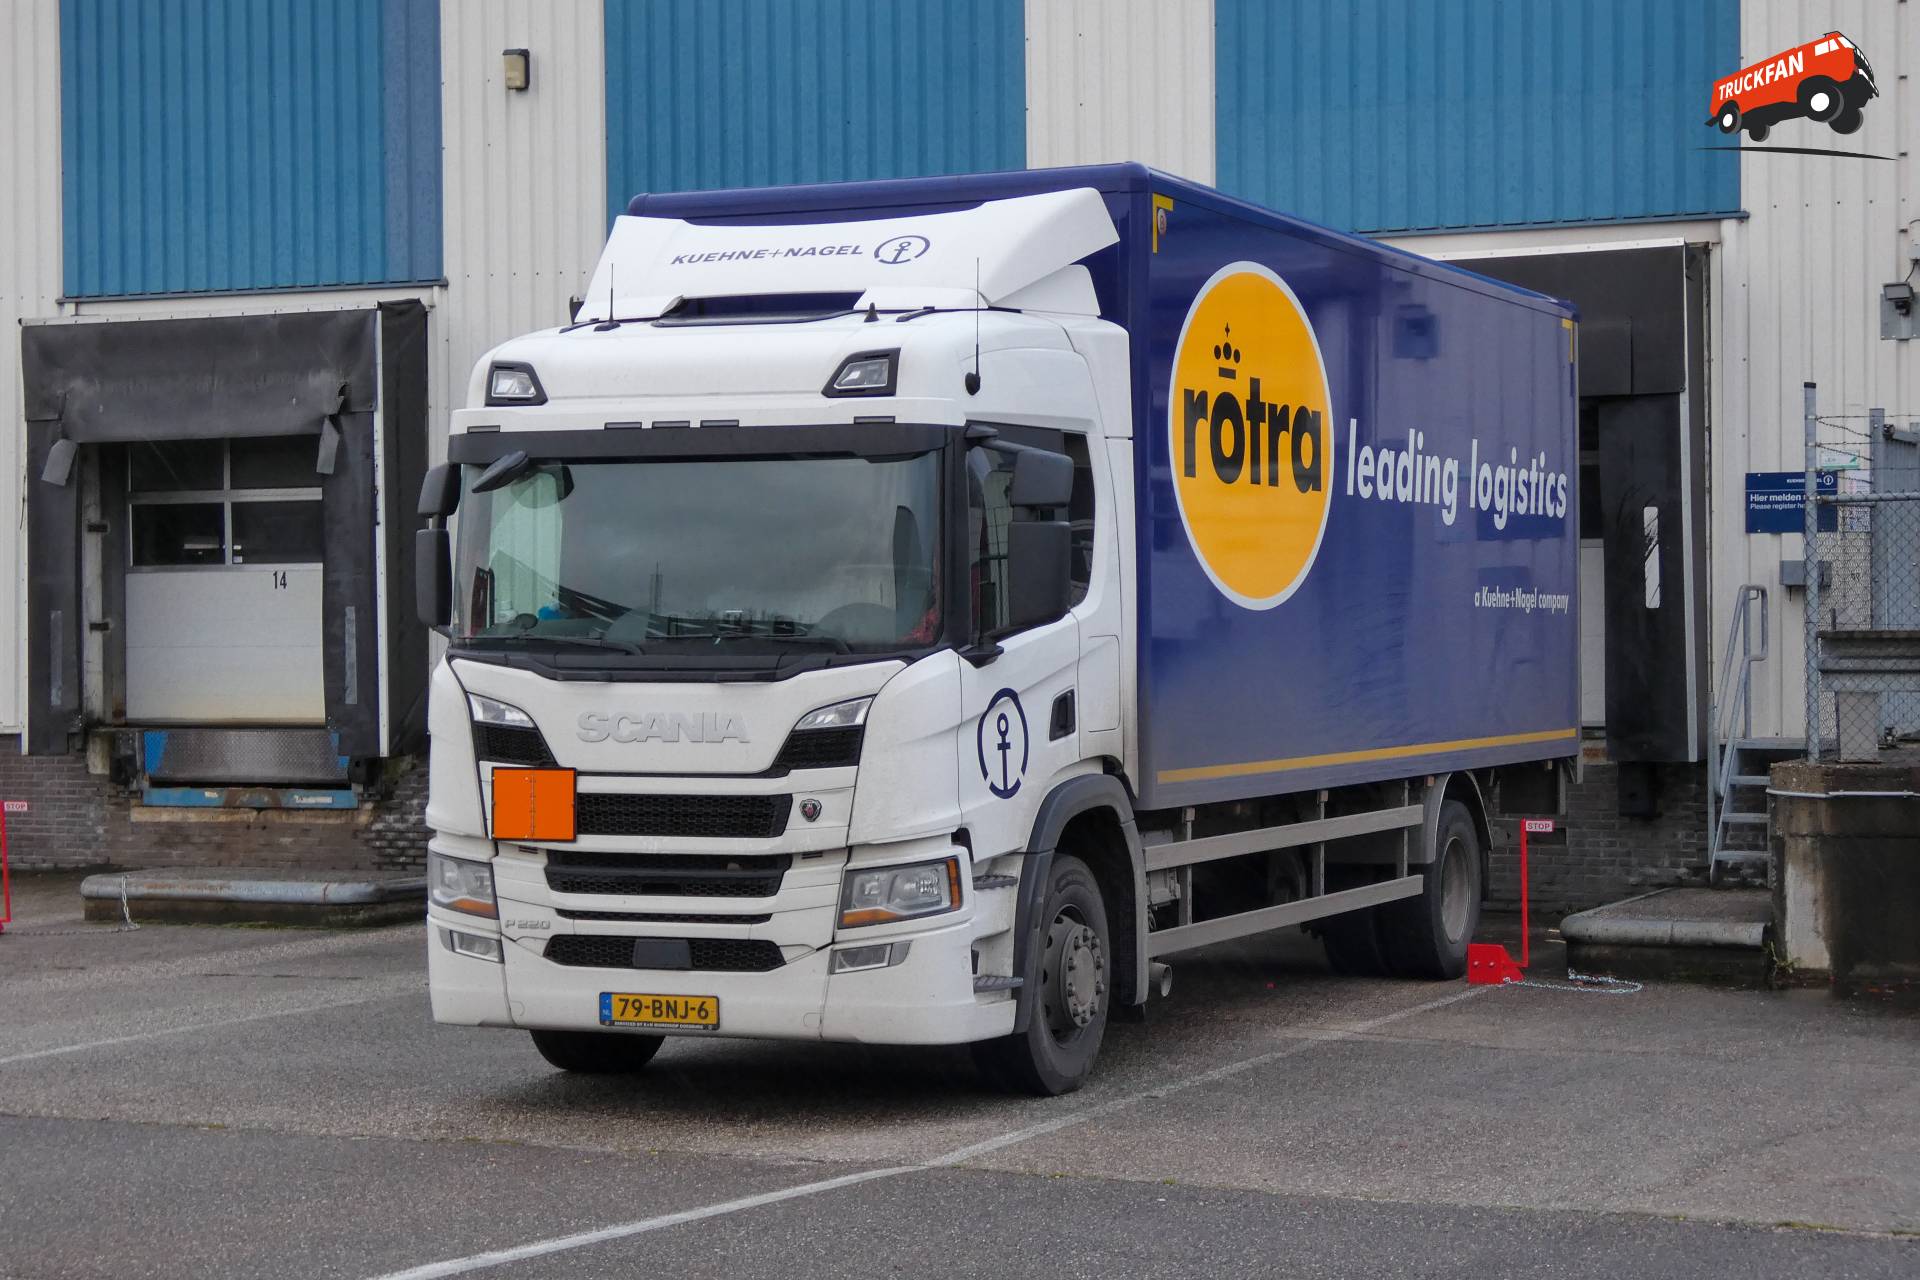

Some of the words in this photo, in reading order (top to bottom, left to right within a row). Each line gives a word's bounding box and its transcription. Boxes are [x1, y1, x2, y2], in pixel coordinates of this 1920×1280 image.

[670, 245, 863, 265] KUEHNE+NAGEL
[1346, 418, 1459, 526] leading
[1470, 438, 1568, 530] logistics
[1750, 493, 1768, 502] Hier
[1769, 493, 1801, 502] melden
[273, 570, 287, 589] 14
[1474, 591, 1480, 607] a
[1482, 585, 1537, 614] Kuehne+Nagel
[1538, 593, 1569, 614] company
[576, 711, 751, 743] SCANIA
[1527, 822, 1551, 830] STOP
[618, 998, 709, 1020] 79-BNJ-6
